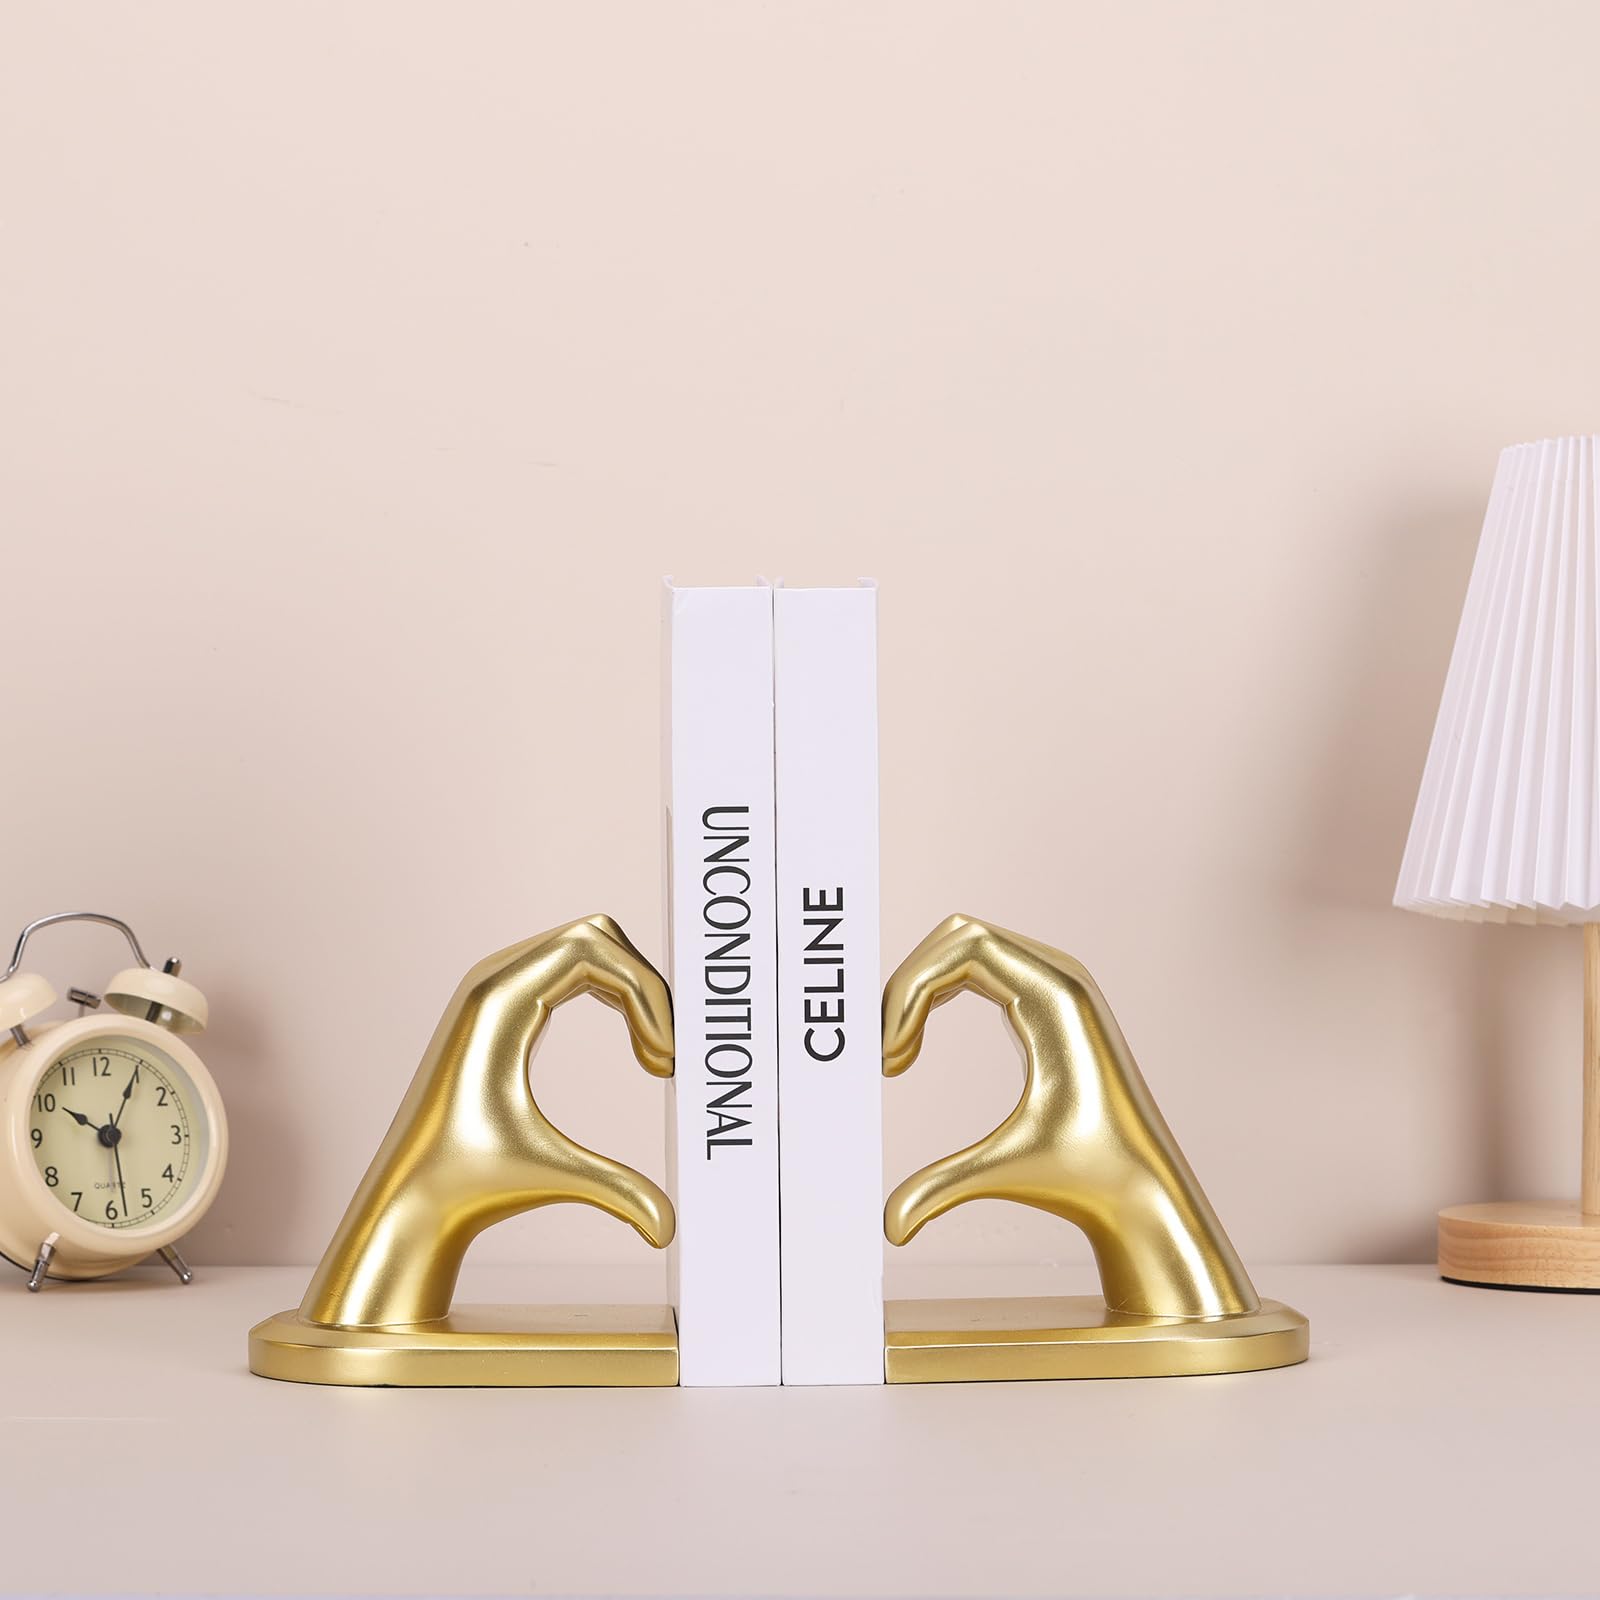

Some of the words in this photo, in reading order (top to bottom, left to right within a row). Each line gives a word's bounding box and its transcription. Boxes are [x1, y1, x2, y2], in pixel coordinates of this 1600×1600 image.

[701, 805, 753, 1161] UNCONDITIONAL
[802, 886, 846, 1062] CELINE
[61, 1066, 76, 1086] 11
[92, 1056, 112, 1077] 12
[37, 1092, 56, 1112] 10
[155, 1086, 169, 1107] 2
[30, 1128, 43, 1149] 9
[170, 1124, 182, 1145] 3
[44, 1166, 60, 1188] 8
[161, 1163, 175, 1183] 4
[70, 1191, 83, 1213] 7
[140, 1188, 153, 1209] 5
[105, 1199, 119, 1221] 6
